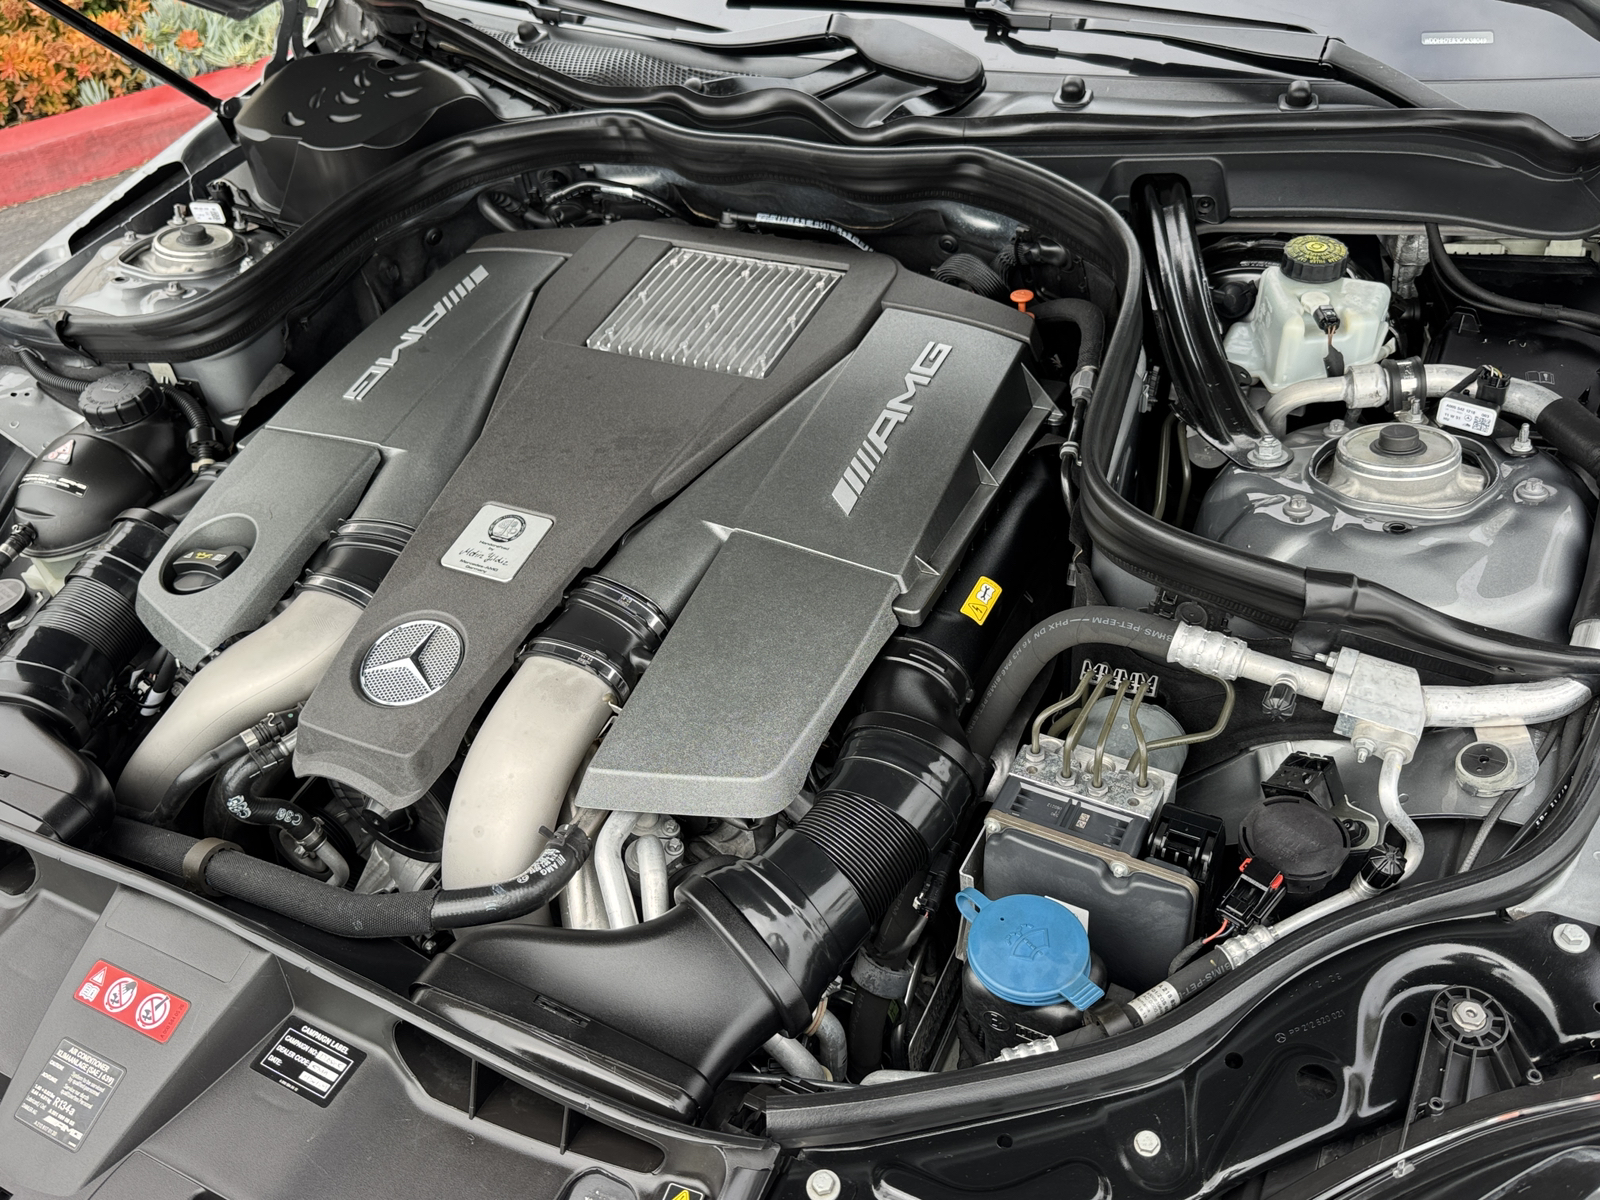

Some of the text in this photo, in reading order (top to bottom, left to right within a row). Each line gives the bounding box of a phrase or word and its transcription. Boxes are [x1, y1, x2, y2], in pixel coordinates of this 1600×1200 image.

[1033, 626, 1047, 640] DN
[1048, 618, 1069, 631] PHX
[284, 1035, 308, 1052] CAMPAIGN
[301, 1025, 350, 1055] CAMPAIGN LABEL
[56, 1049, 90, 1071] KLIMAANLAGE
[276, 1044, 296, 1059] DEALER
[77, 1050, 110, 1073] CONDITIONER
[52, 1096, 76, 1116] R134a
